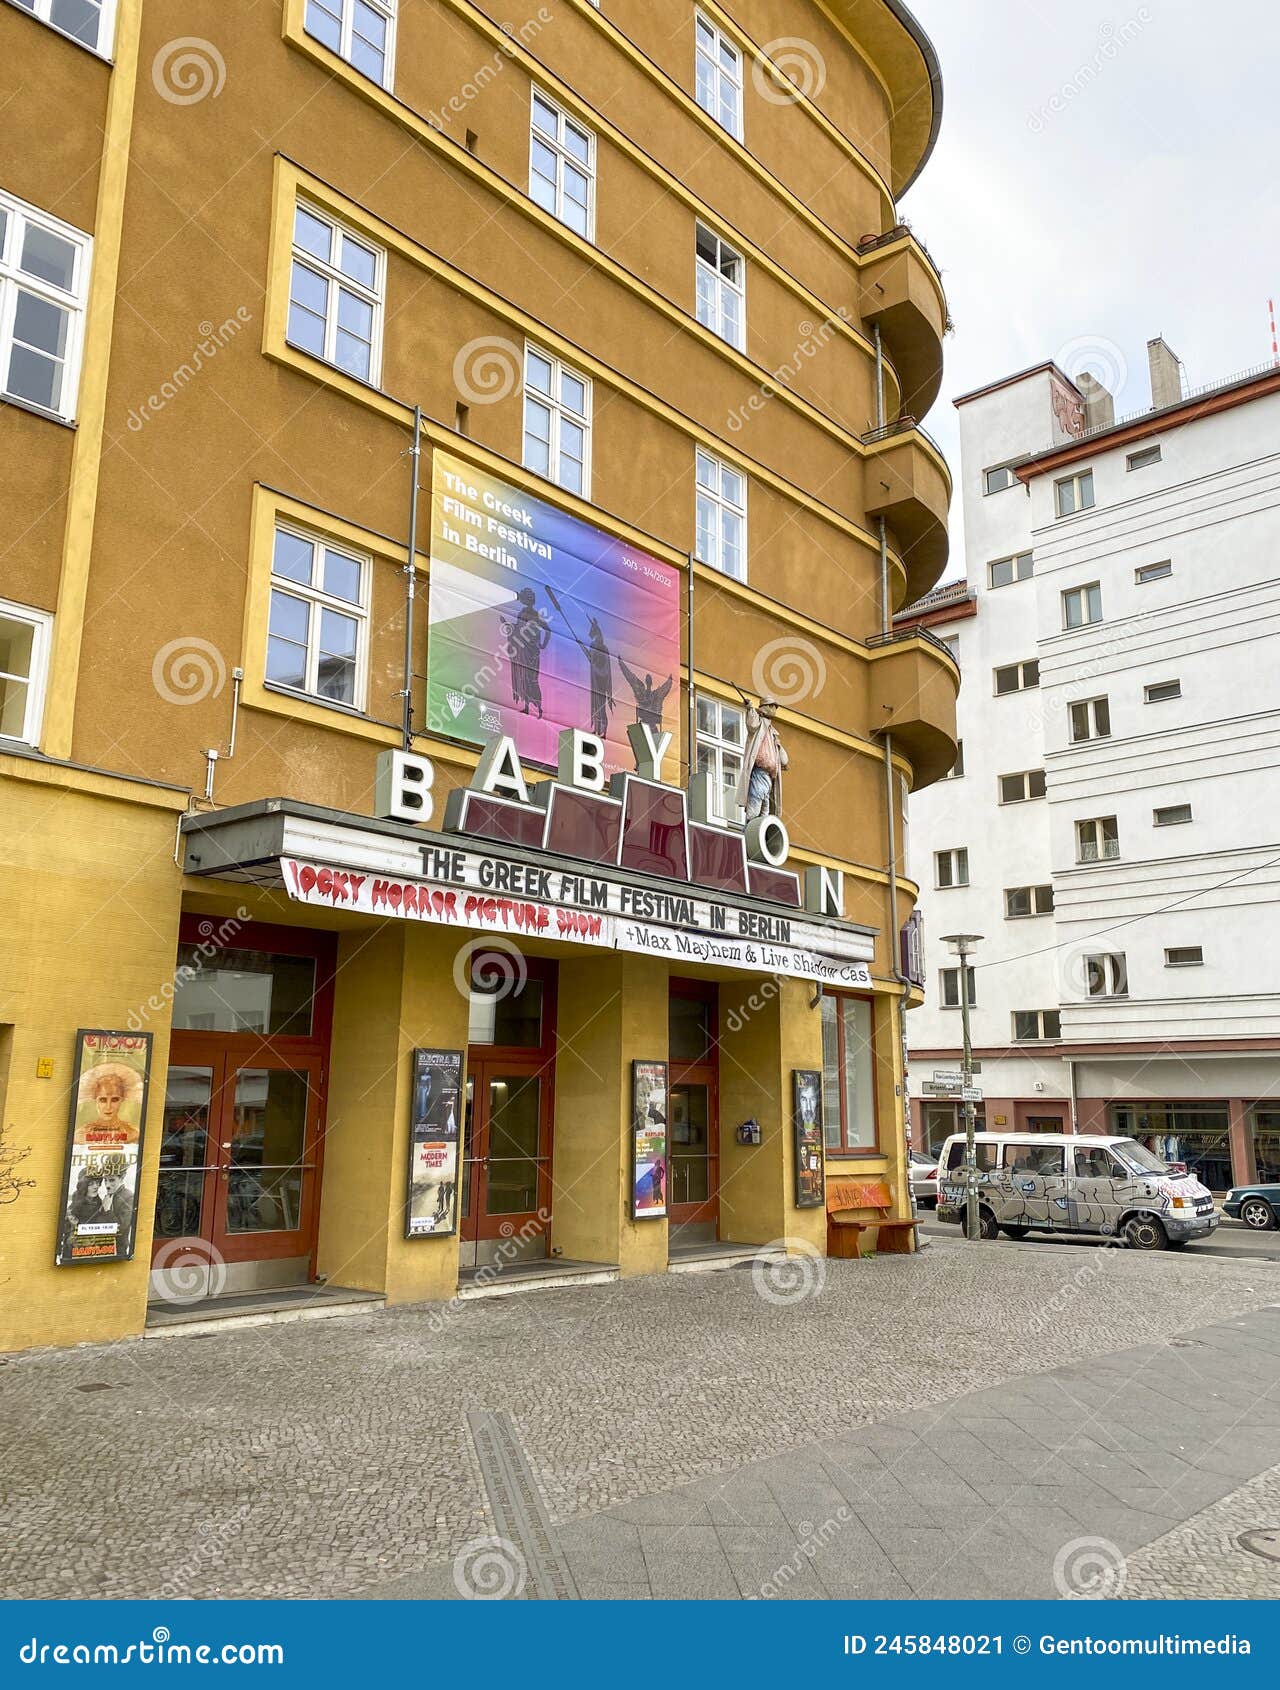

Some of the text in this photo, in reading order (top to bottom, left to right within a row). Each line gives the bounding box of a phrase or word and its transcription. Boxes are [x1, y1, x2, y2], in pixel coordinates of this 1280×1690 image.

[443, 471, 533, 528] The Greek
[442, 521, 519, 570] in Berlin
[443, 496, 552, 560] Film Festival
[379, 724, 846, 917] BABYLON
[371, 879, 458, 923] HORROR
[464, 895, 549, 935] PICTURE
[556, 908, 602, 941] SHOW
[418, 846, 791, 943] THE GREEK FILM FESTIVAL IN BERLIN
[676, 934, 741, 961] Mayhem
[745, 945, 757, 964] &
[761, 946, 789, 968] Live
[793, 953, 837, 979] Shadow
[840, 965, 868, 982] Cas
[72, 1153, 138, 1166] THE GOLD
[85, 1164, 121, 1176] RUSH
[420, 1152, 448, 1160] MODERN
[425, 1160, 443, 1168] TIMES
